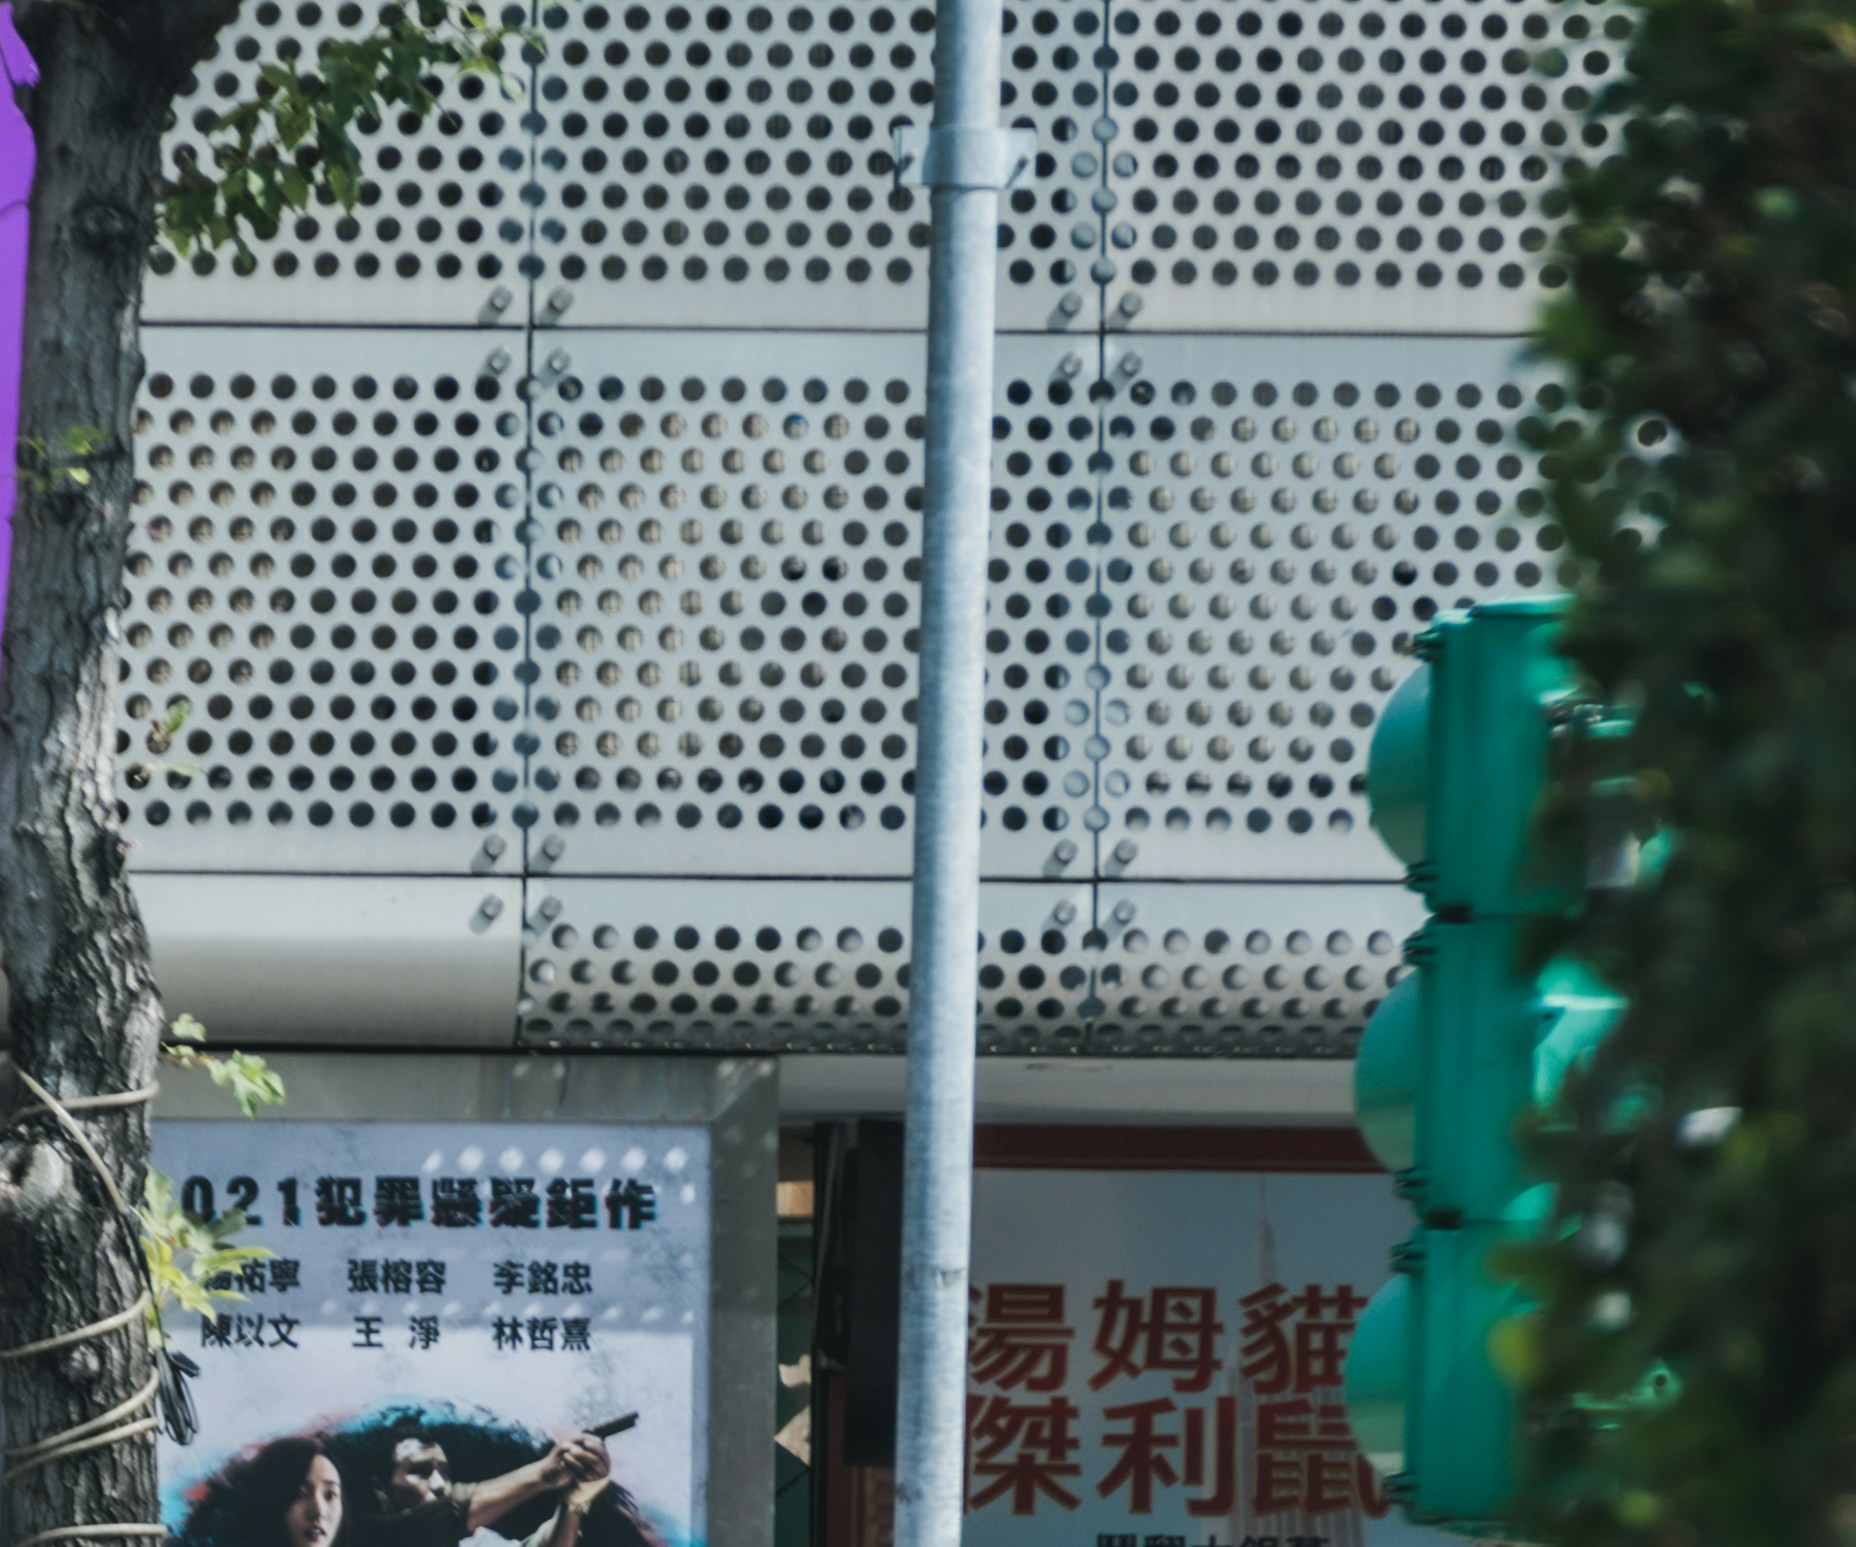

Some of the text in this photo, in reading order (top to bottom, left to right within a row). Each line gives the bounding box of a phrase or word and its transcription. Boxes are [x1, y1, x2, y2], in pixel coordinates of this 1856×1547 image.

[181, 1175, 656, 1230] 021犯罪懸疑鉅作
[347, 1258, 446, 1294] 張榕容
[493, 1260, 592, 1295] 李銘忠
[201, 1313, 300, 1349] 陳以文
[493, 1316, 592, 1351] 林哲熹
[967, 1278, 1366, 1395] 湯姆貓
[963, 1392, 1392, 1518] 傑利鼠
